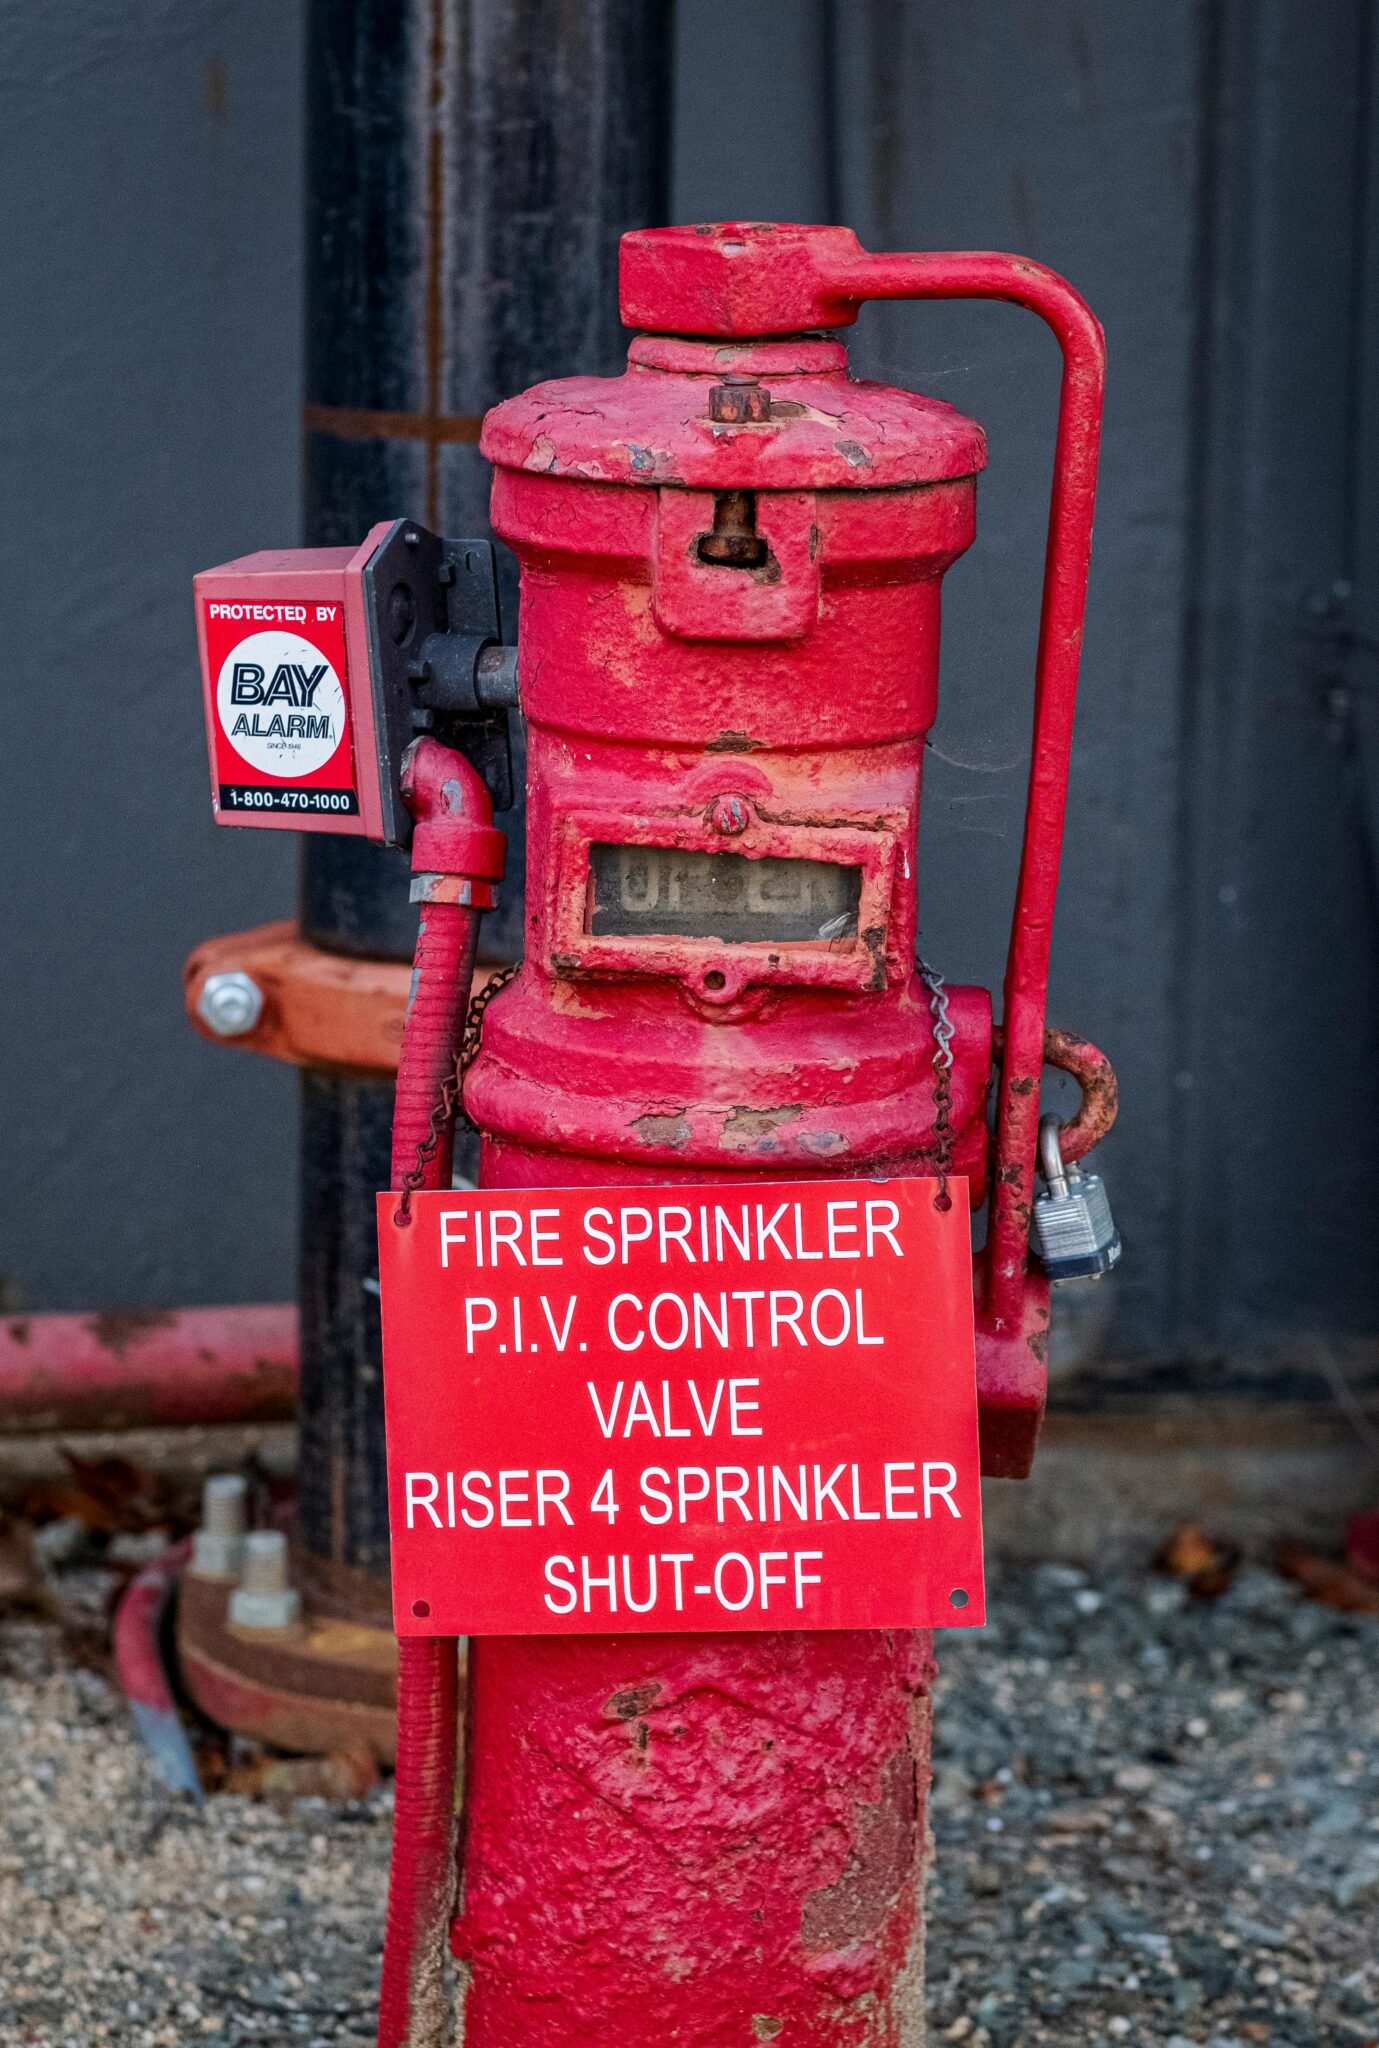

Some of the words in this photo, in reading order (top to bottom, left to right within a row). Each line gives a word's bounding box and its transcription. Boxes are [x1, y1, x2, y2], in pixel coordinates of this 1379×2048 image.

[209, 603, 307, 622] PROTECTED
[316, 606, 337, 622] BY
[230, 663, 329, 708] BAY
[231, 713, 330, 739] ALARM
[266, 742, 286, 750] SINCE
[230, 790, 350, 810] 1-800-470-1000
[440, 1208, 563, 1268] FIRE
[582, 1199, 905, 1267] SPRINKLER
[464, 1294, 588, 1354] P.I.V.
[606, 1287, 885, 1353] CONTROL
[587, 1377, 763, 1439] VALVE
[404, 1469, 575, 1529] RISER
[590, 1468, 620, 1525] 4
[639, 1461, 962, 1524] SPRINKLER
[543, 1550, 824, 1615] SHUT-OFF
